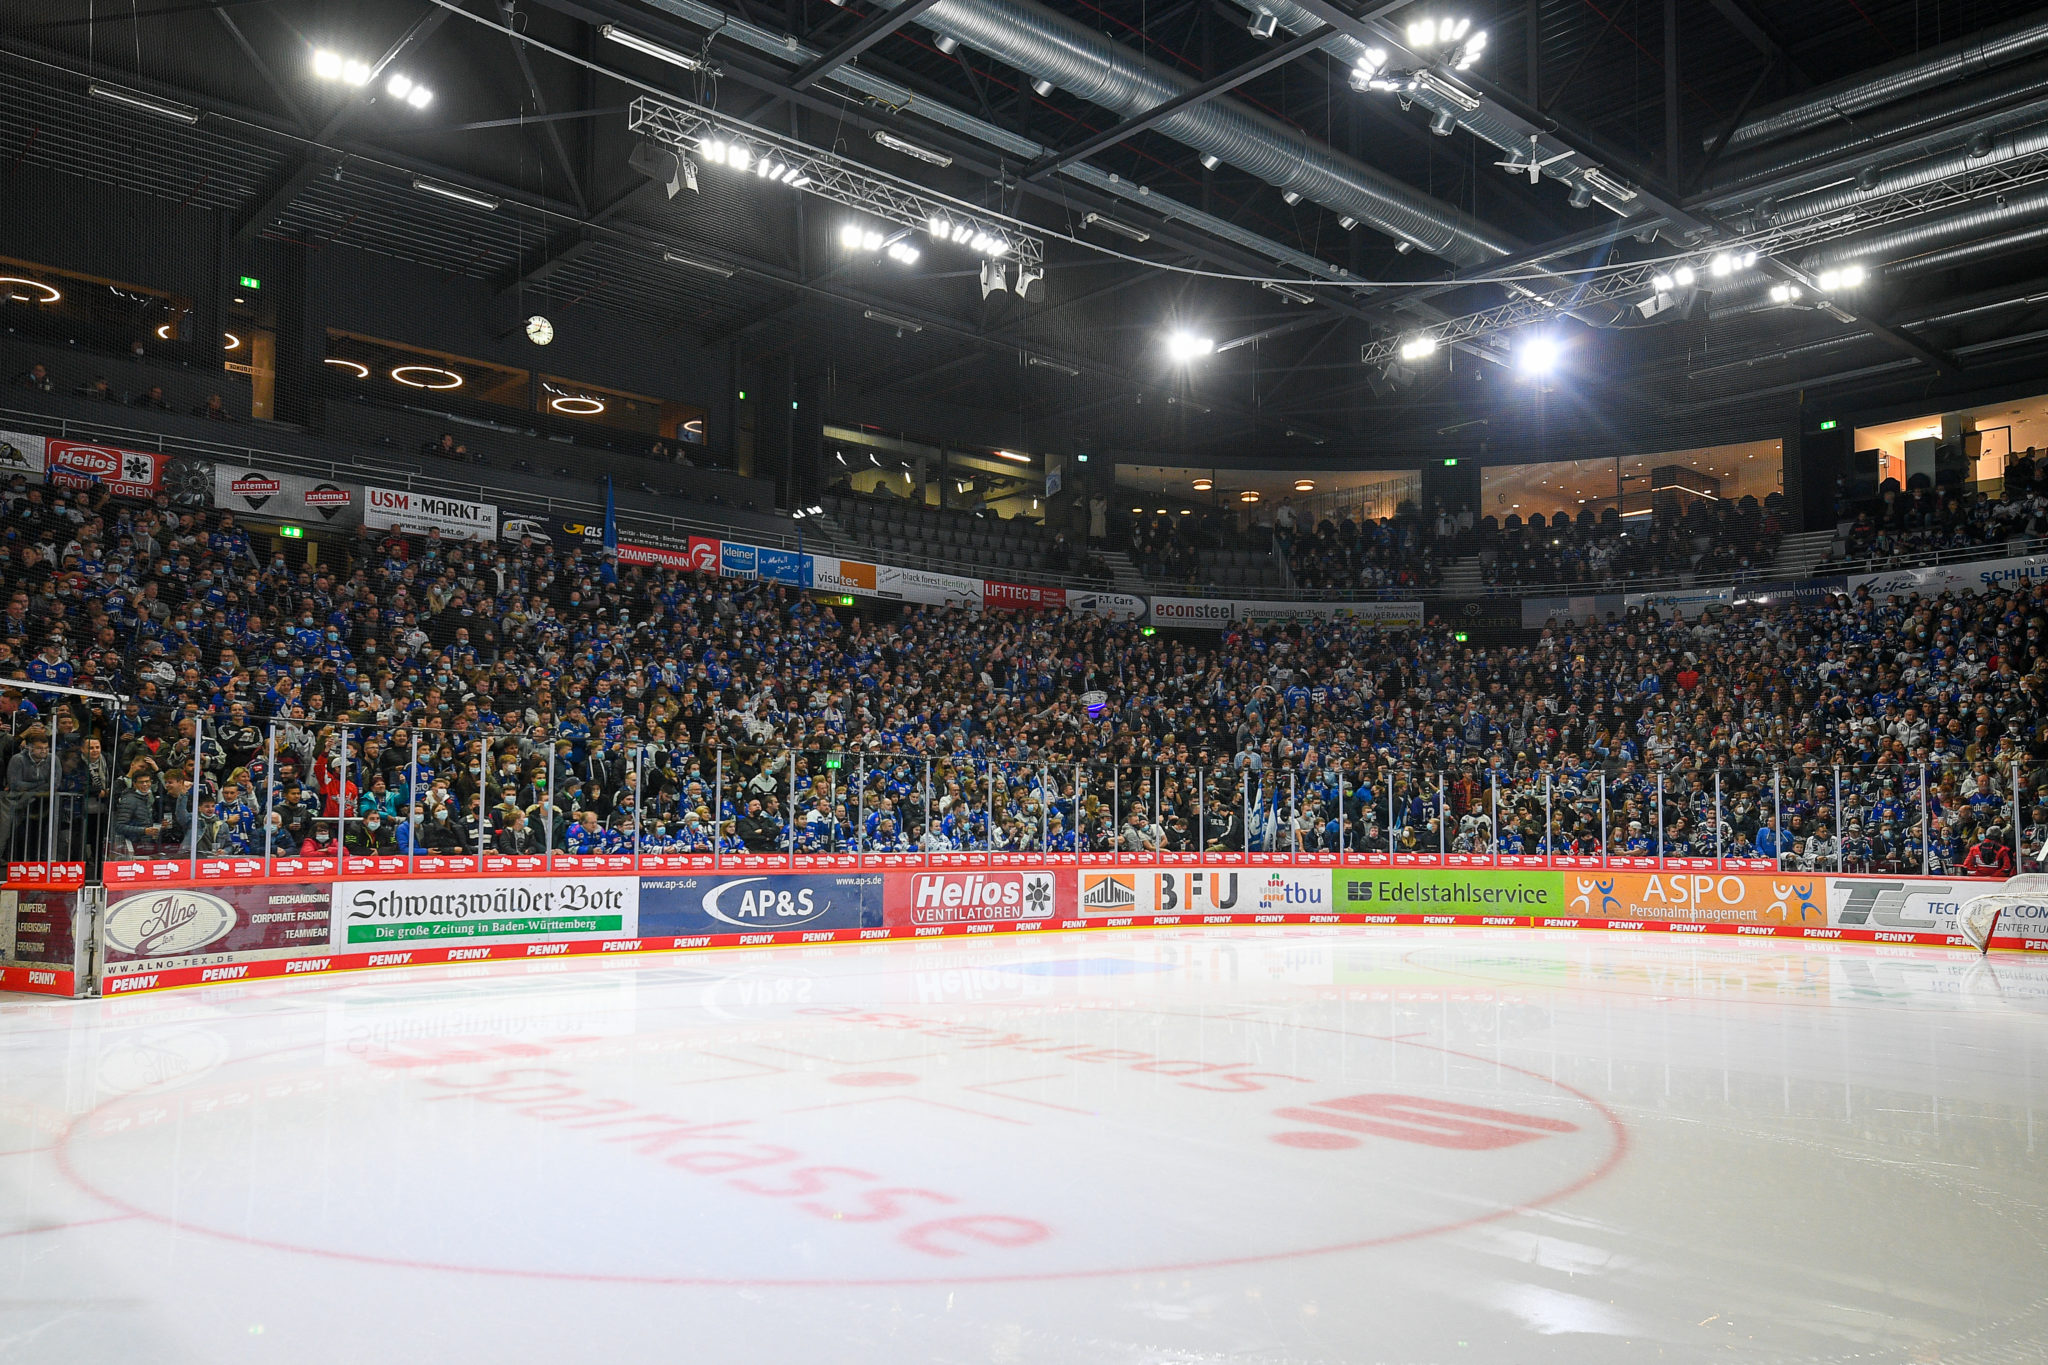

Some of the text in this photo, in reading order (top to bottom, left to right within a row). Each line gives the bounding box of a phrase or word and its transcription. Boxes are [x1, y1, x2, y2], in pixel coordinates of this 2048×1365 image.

[58, 451, 118, 471] Helios
[233, 482, 273, 490] antenne
[306, 492, 343, 500] antenne
[371, 490, 409, 510] USM
[422, 498, 481, 520] MARKT
[584, 526, 603, 538] GLS
[618, 548, 690, 568] ZIMMERMANN
[723, 546, 754, 559] kleiner
[818, 571, 859, 587] visutec
[902, 572, 920, 582] black
[922, 576, 940, 585] forest
[1980, 566, 2048, 583] SCHULE
[1796, 586, 1843, 597] WOHNEN
[1098, 596, 1134, 606] F.T. Cars
[1156, 603, 1235, 618] econsteel
[1242, 608, 1327, 618] Schwarzwälder Bote
[1357, 610, 1421, 620] ZIMMERMANN
[1422, 808, 1436, 822] 13
[641, 879, 697, 890] www.ap-s.de
[836, 876, 882, 887] www.ap-s.de
[1643, 874, 1746, 905] ASPO
[268, 893, 330, 905] MERCHANDISING
[916, 876, 1020, 908] Helios
[1154, 873, 1238, 910] BFU
[1284, 882, 1322, 904] tbu
[1380, 882, 1548, 904] Edelstahlservice
[347, 884, 624, 920] Schwarzwälder Bote
[738, 888, 814, 918] AP&S
[1834, 881, 1952, 928] TC
[140, 895, 198, 937] Alno
[252, 910, 329, 924] CORPORATE FASHION
[916, 906, 1020, 922] VENTILATOREN
[1630, 904, 1758, 922] Personalmanagement
[285, 928, 328, 939] TEAMWEAR
[376, 918, 597, 938] Die große Zeitung in Baden-Württemberg
[418, 1066, 1054, 1259] Sparkasse
